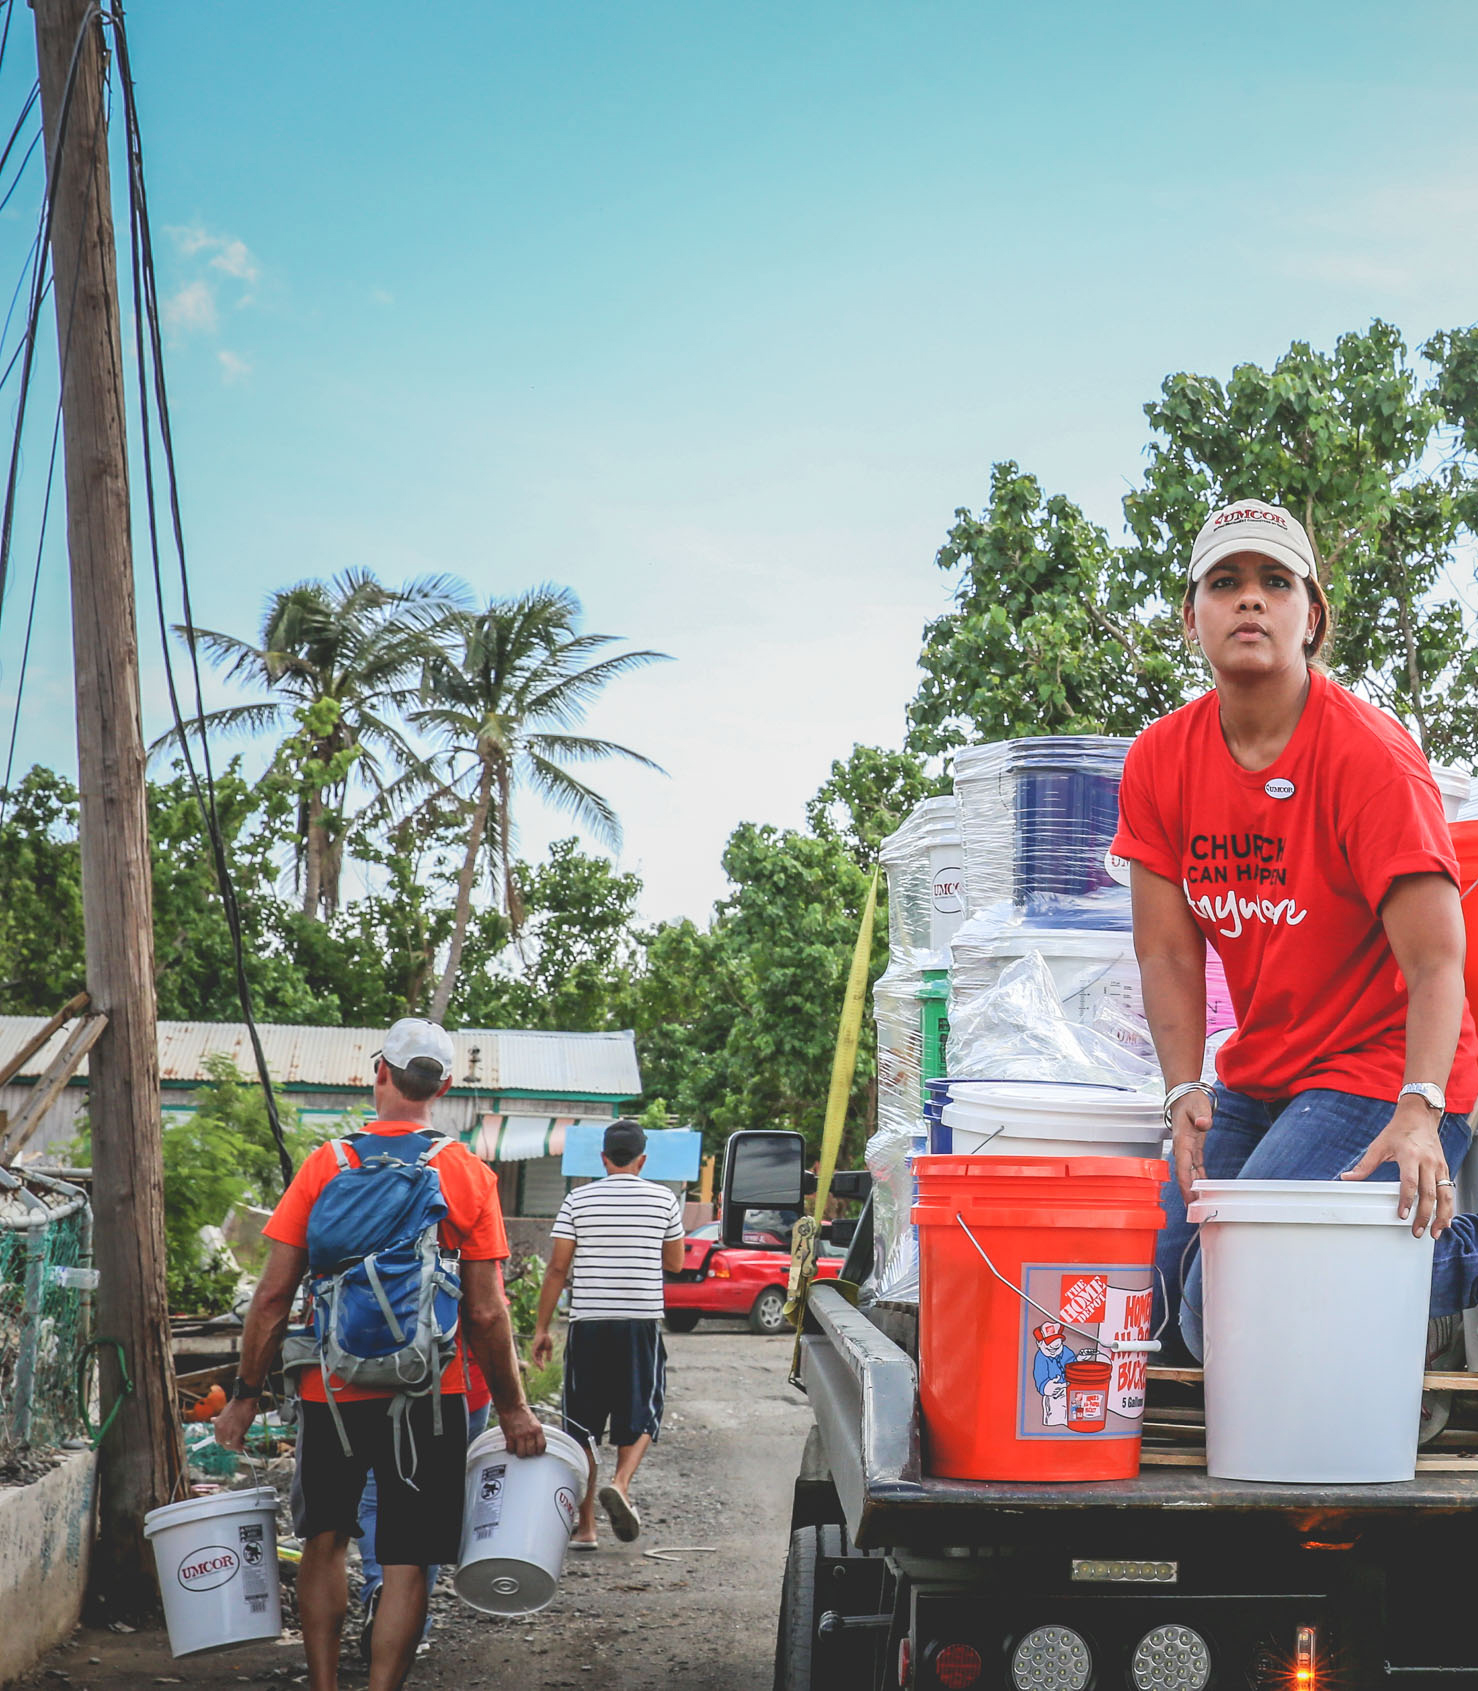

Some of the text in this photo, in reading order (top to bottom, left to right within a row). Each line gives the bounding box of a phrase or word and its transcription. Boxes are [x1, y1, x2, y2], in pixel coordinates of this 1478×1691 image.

[1223, 509, 1286, 527] UMCOR
[1188, 866, 1228, 884] CAN
[1065, 1279, 1087, 1298] THE
[1060, 1276, 1107, 1323] HOME
[1077, 1292, 1106, 1323] DEPOT
[1121, 1396, 1127, 1408] 5
[181, 1554, 234, 1579] UMCOR
